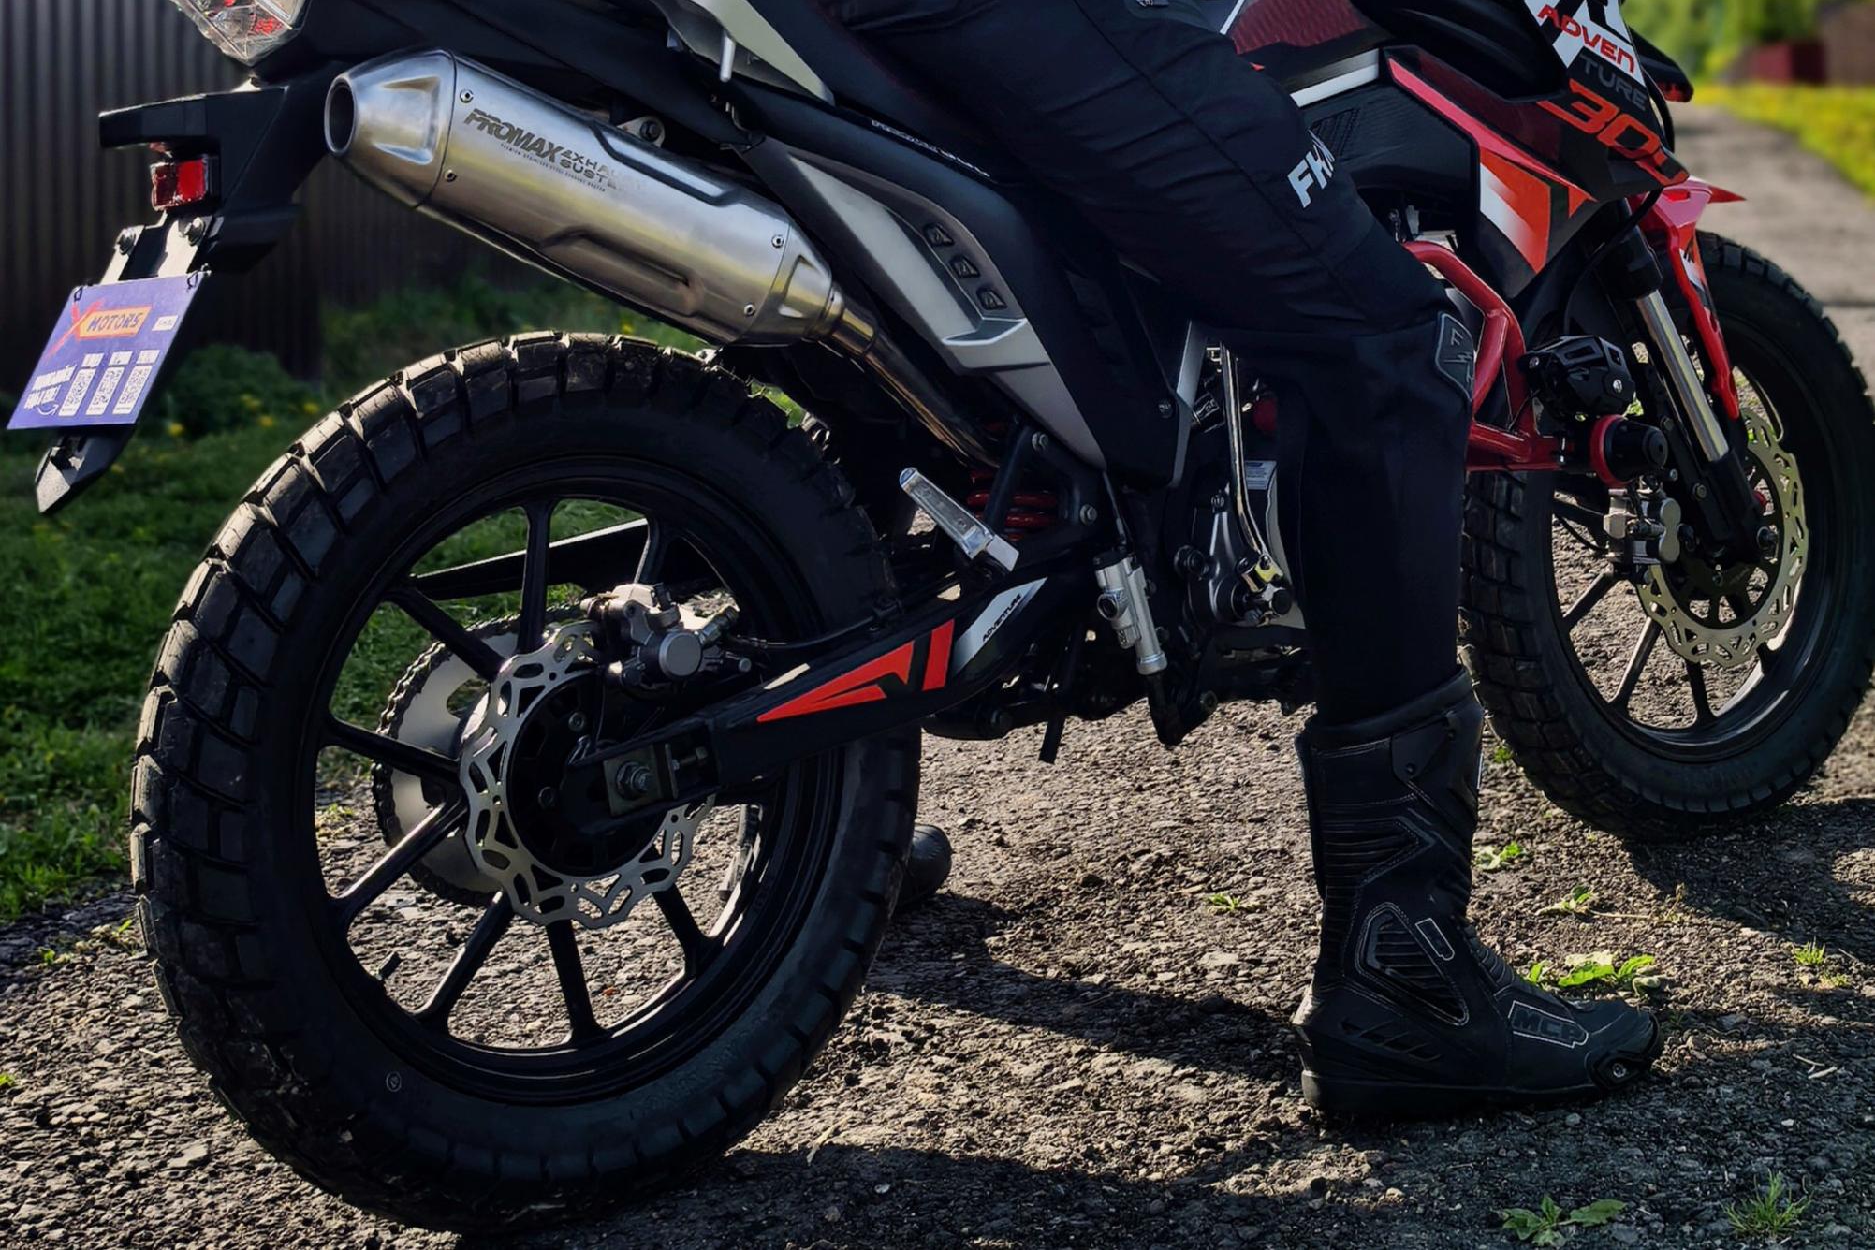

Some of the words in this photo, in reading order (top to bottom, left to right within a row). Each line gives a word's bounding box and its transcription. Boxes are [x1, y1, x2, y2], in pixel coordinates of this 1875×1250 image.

[1537, 4, 1636, 74] ADVEN
[1579, 54, 1649, 111] TURE
[463, 108, 564, 163] PROMAX
[86, 312, 143, 332] MOTORS
